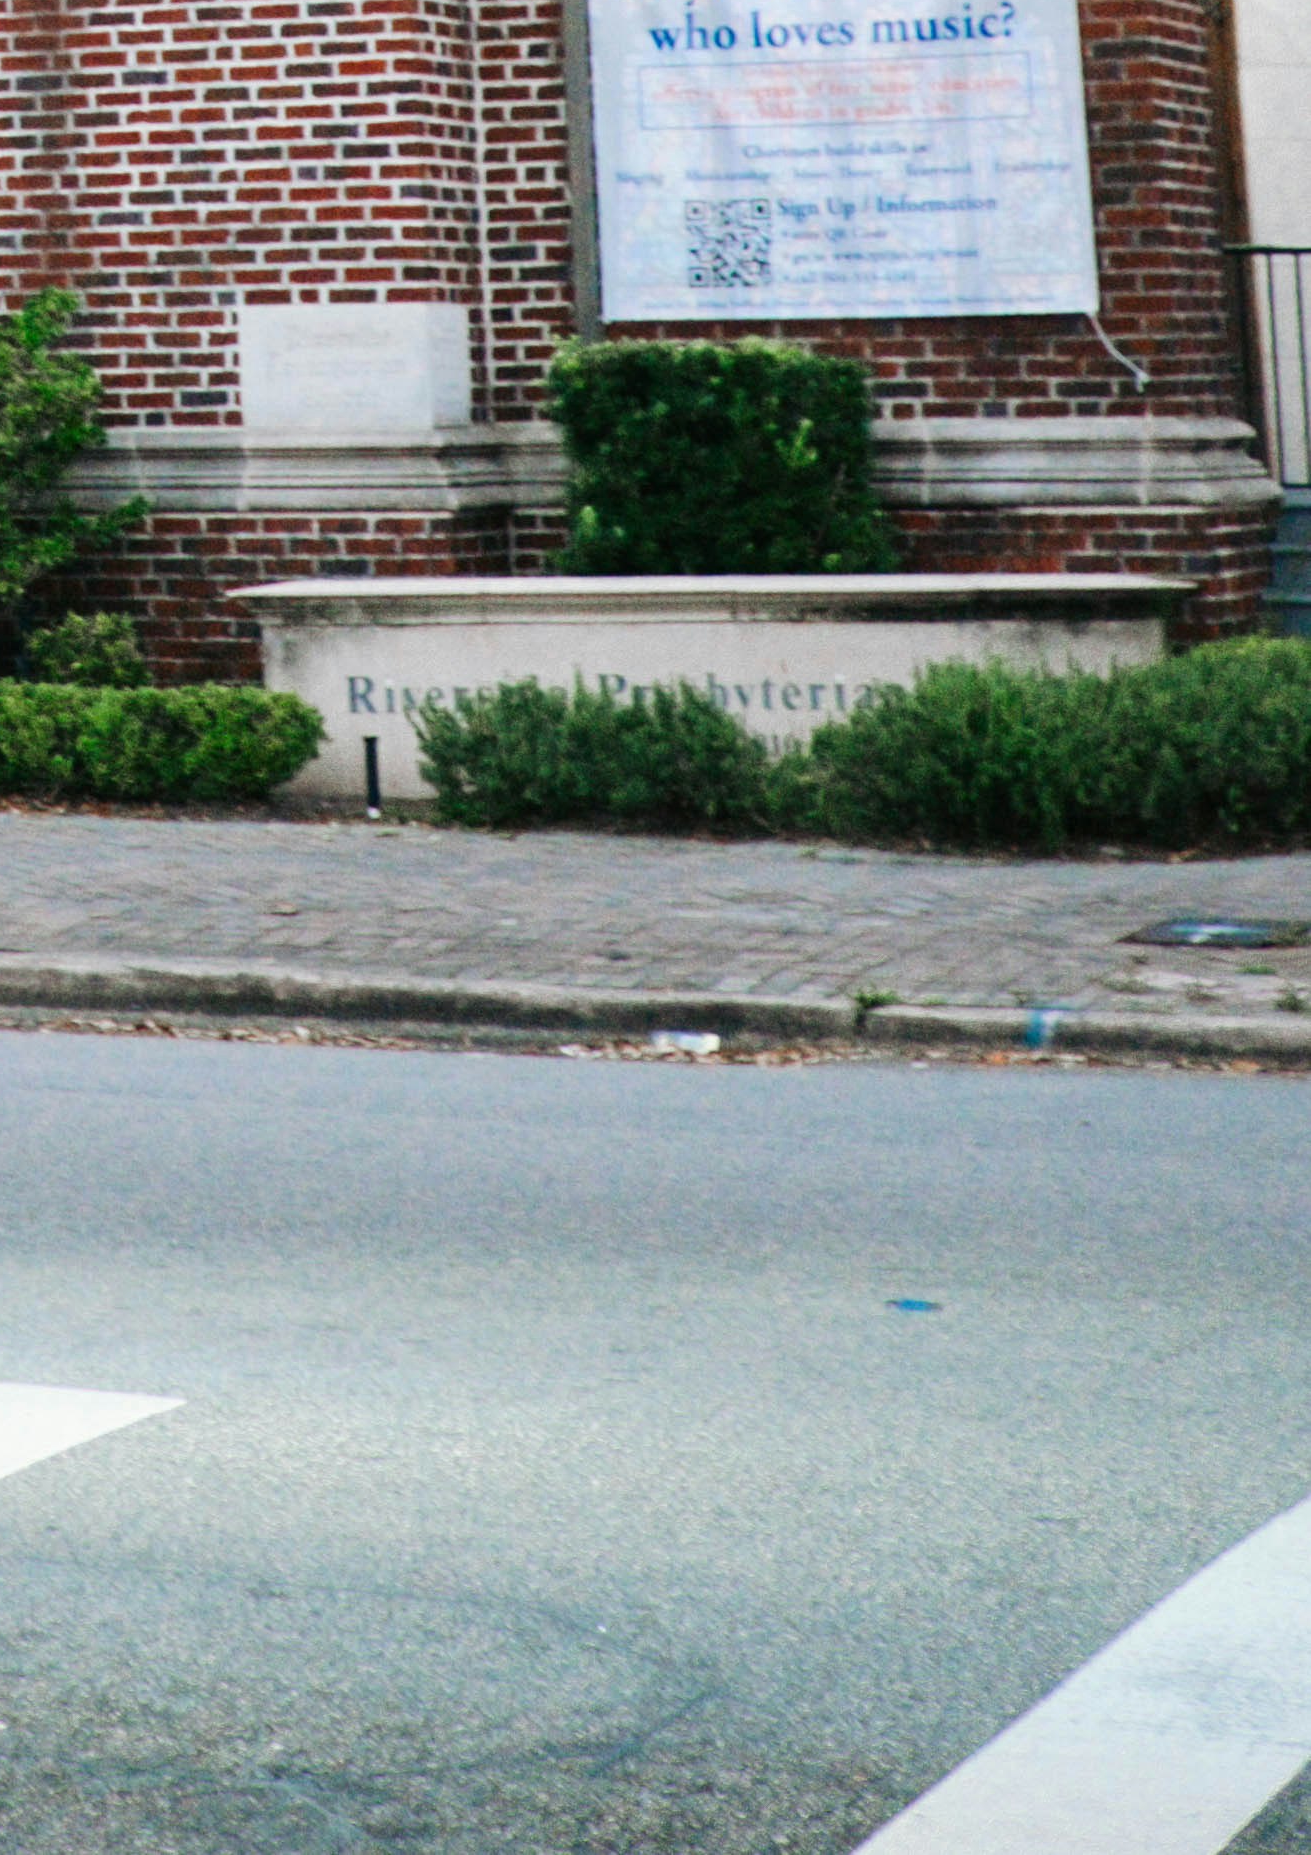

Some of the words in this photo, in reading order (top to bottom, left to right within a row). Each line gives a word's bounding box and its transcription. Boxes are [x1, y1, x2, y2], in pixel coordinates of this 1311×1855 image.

[649, 7, 736, 51] who
[752, 10, 854, 49] loves
[871, 1, 1016, 44] music?
[777, 196, 819, 222] Sign
[827, 195, 856, 220] Up
[876, 193, 997, 213] Information
